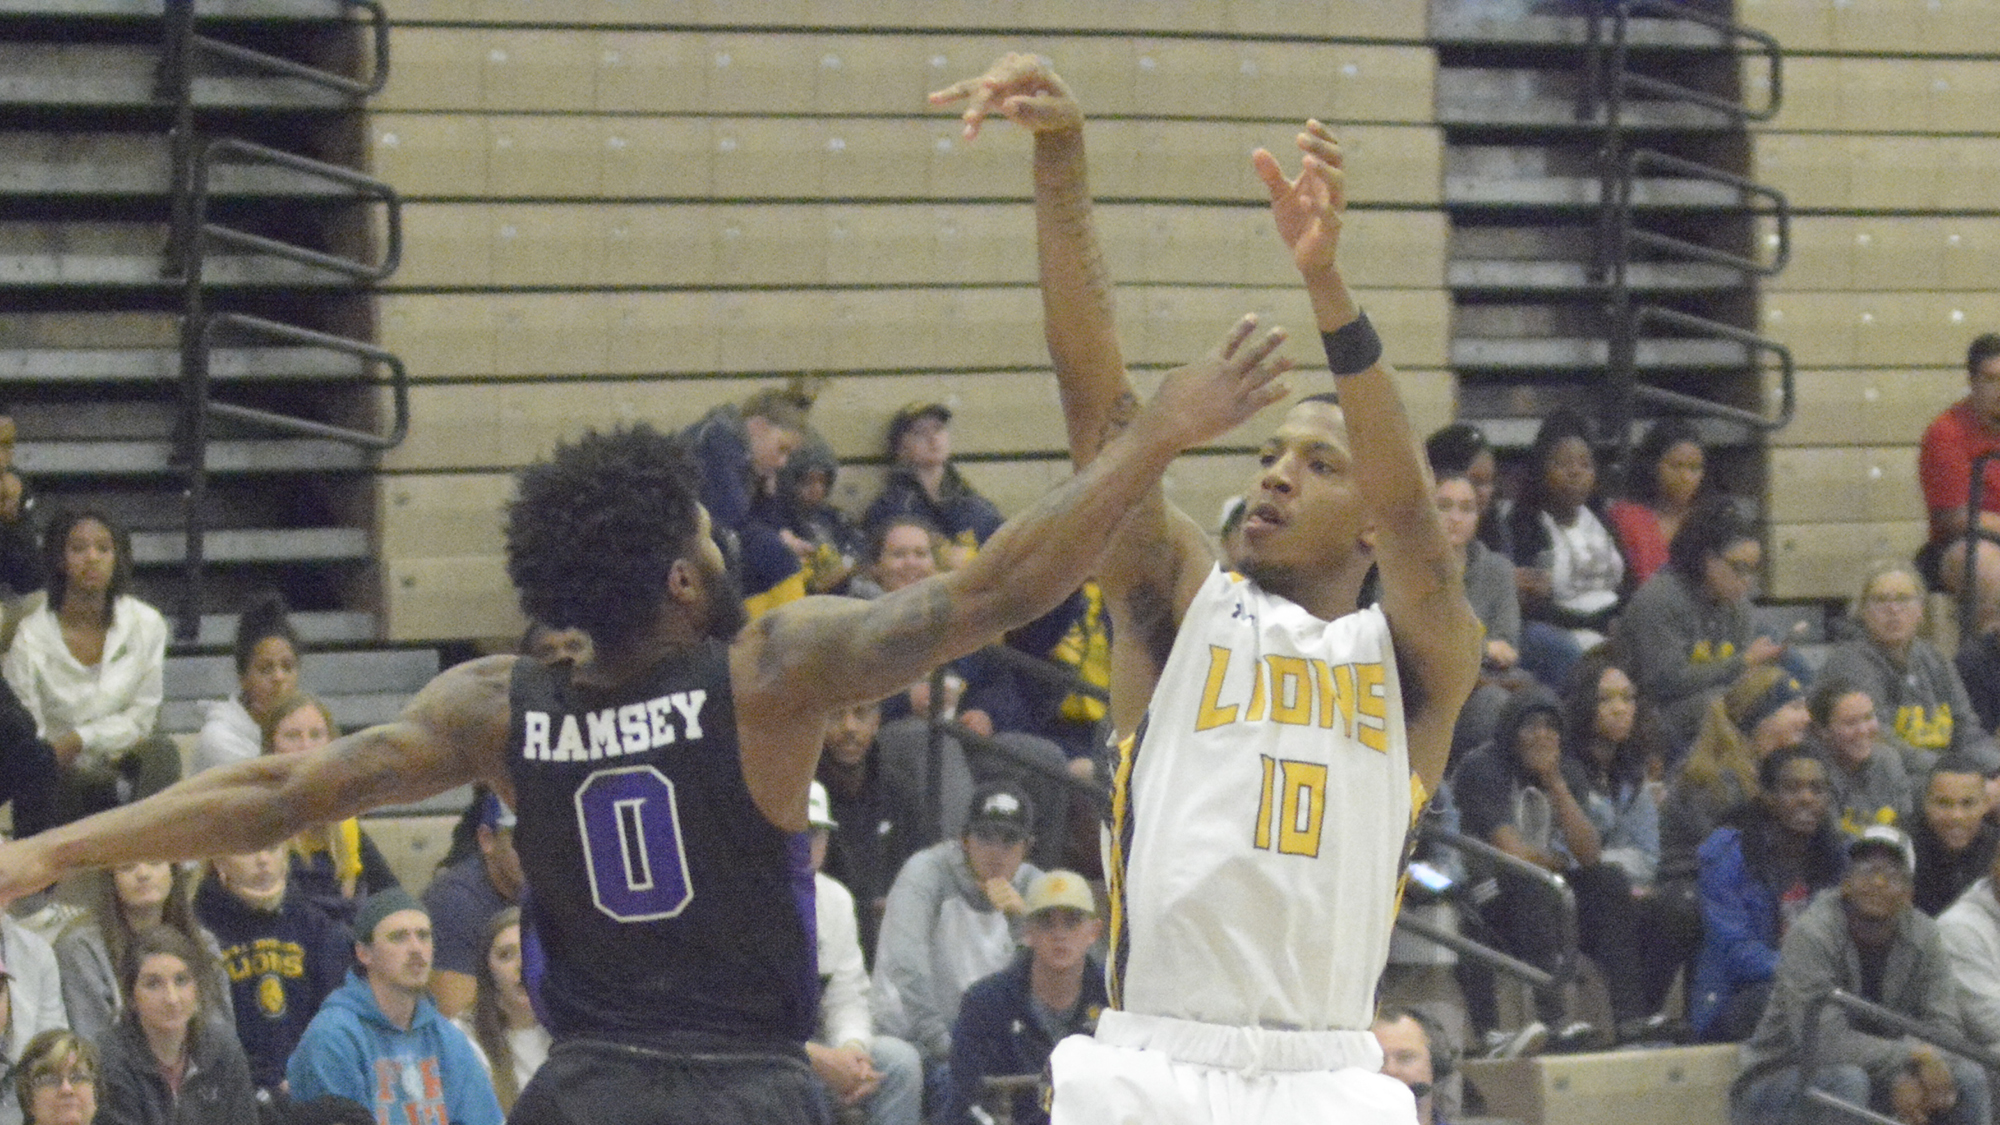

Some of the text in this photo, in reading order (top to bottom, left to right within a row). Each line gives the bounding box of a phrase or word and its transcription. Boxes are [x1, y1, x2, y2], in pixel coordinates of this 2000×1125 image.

[523, 689, 707, 762] RAMSEY
[1194, 643, 1387, 755] LIONS
[574, 765, 694, 922] 0
[1253, 753, 1328, 859] 10
